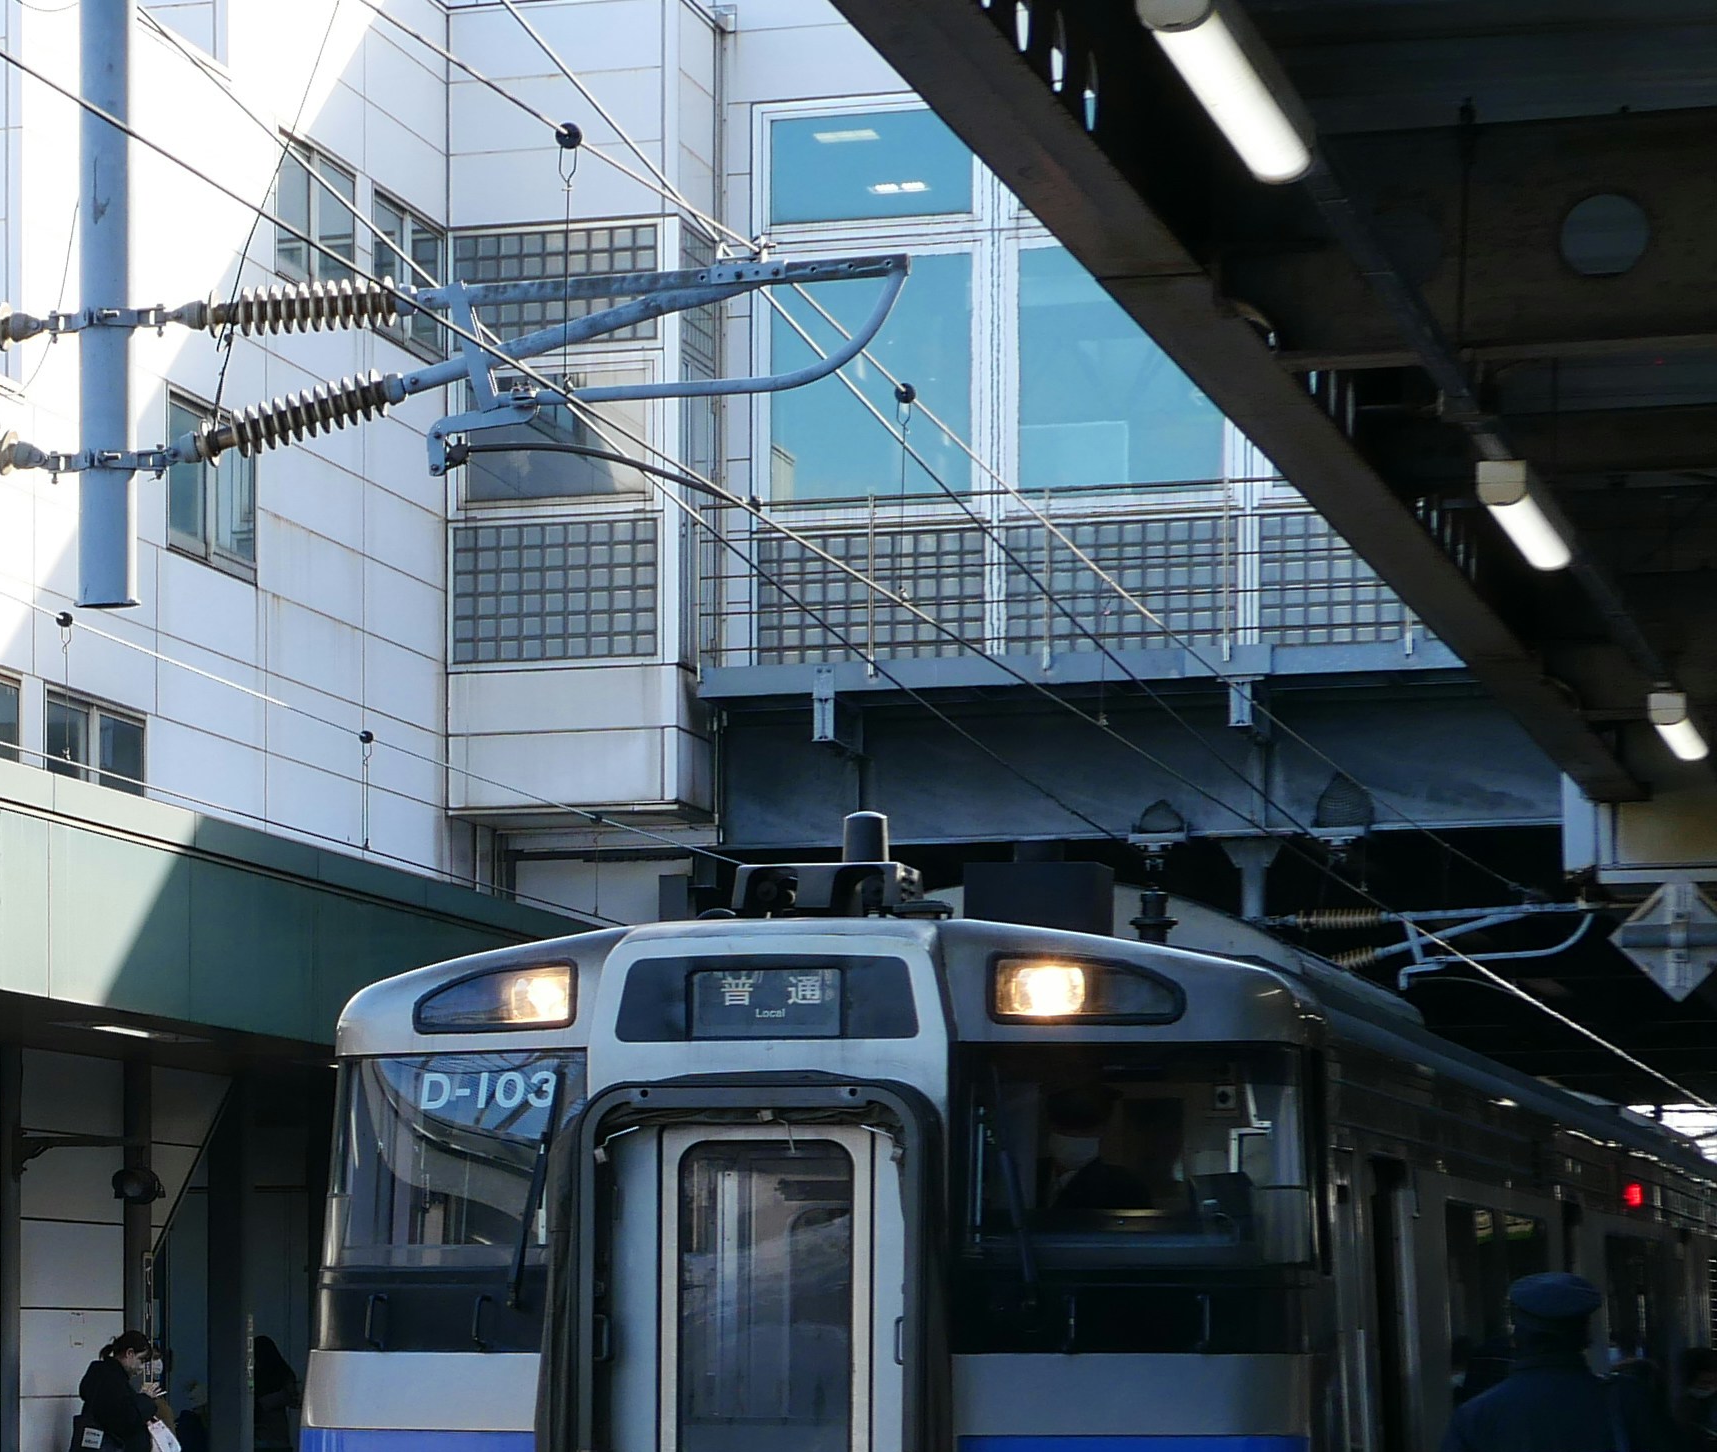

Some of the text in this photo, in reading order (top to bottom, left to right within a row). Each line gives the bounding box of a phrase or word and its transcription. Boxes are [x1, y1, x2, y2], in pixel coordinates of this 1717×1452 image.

[720, 976, 822, 1006] 普通
[755, 1008, 786, 1018] Local
[420, 1070, 557, 1110] D-103
